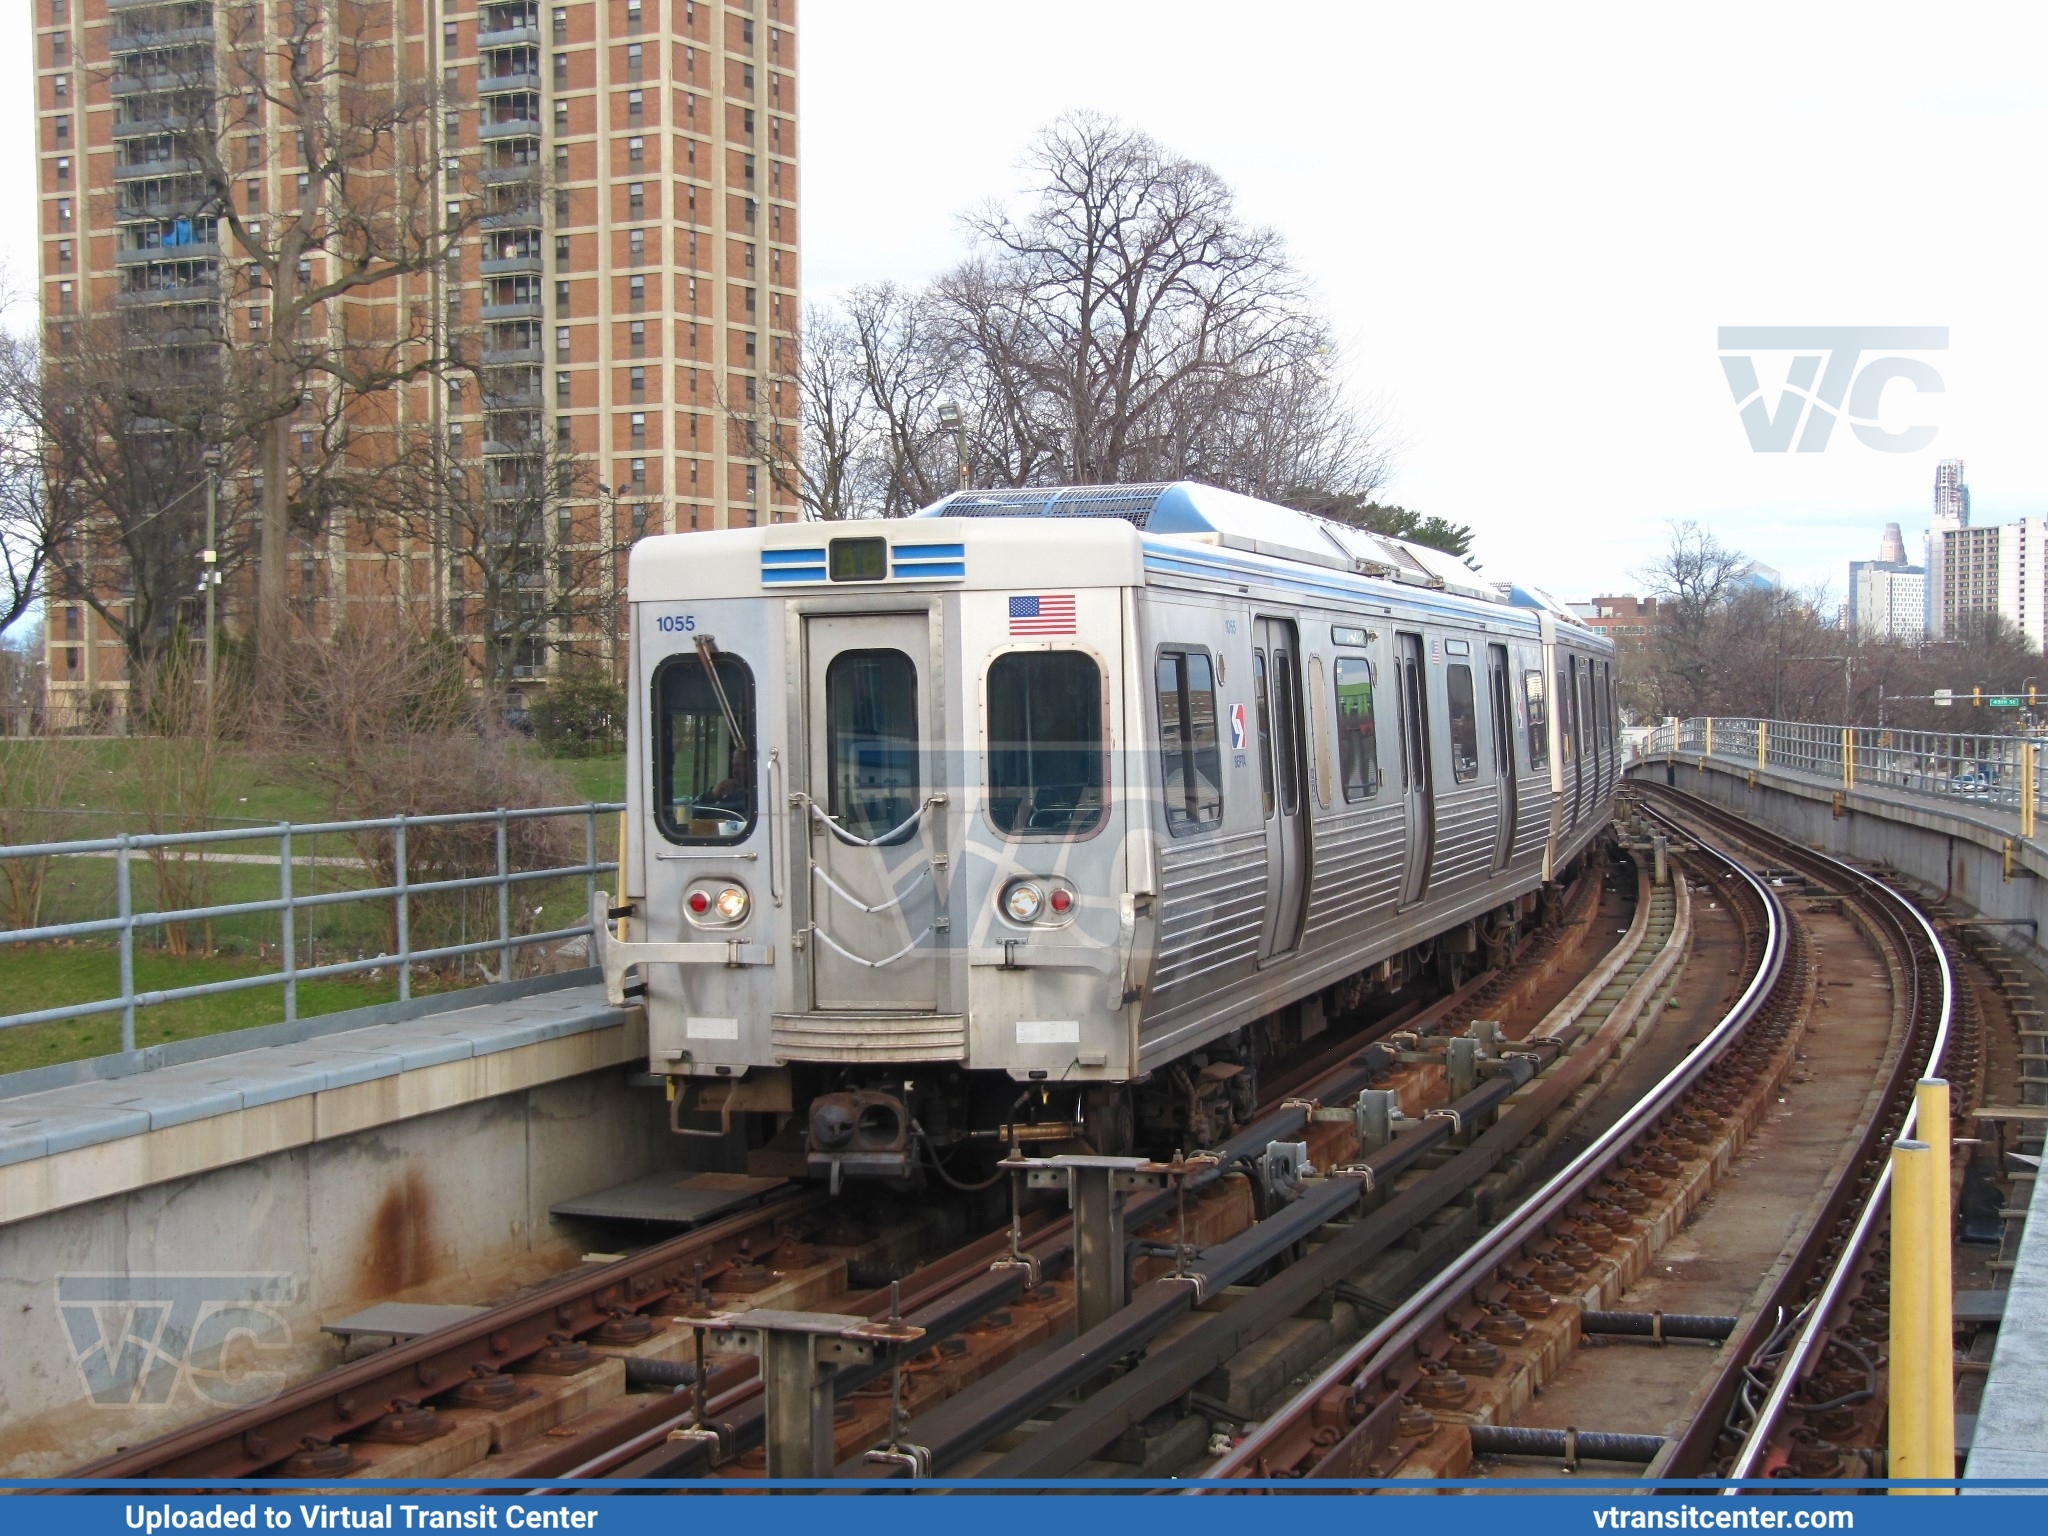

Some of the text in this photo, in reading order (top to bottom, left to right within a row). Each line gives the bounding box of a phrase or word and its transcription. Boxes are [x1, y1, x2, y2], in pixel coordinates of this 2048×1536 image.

[656, 615, 695, 632] 1055
[1225, 619, 1237, 635] 1055
[1233, 754, 1247, 769] SEPTA
